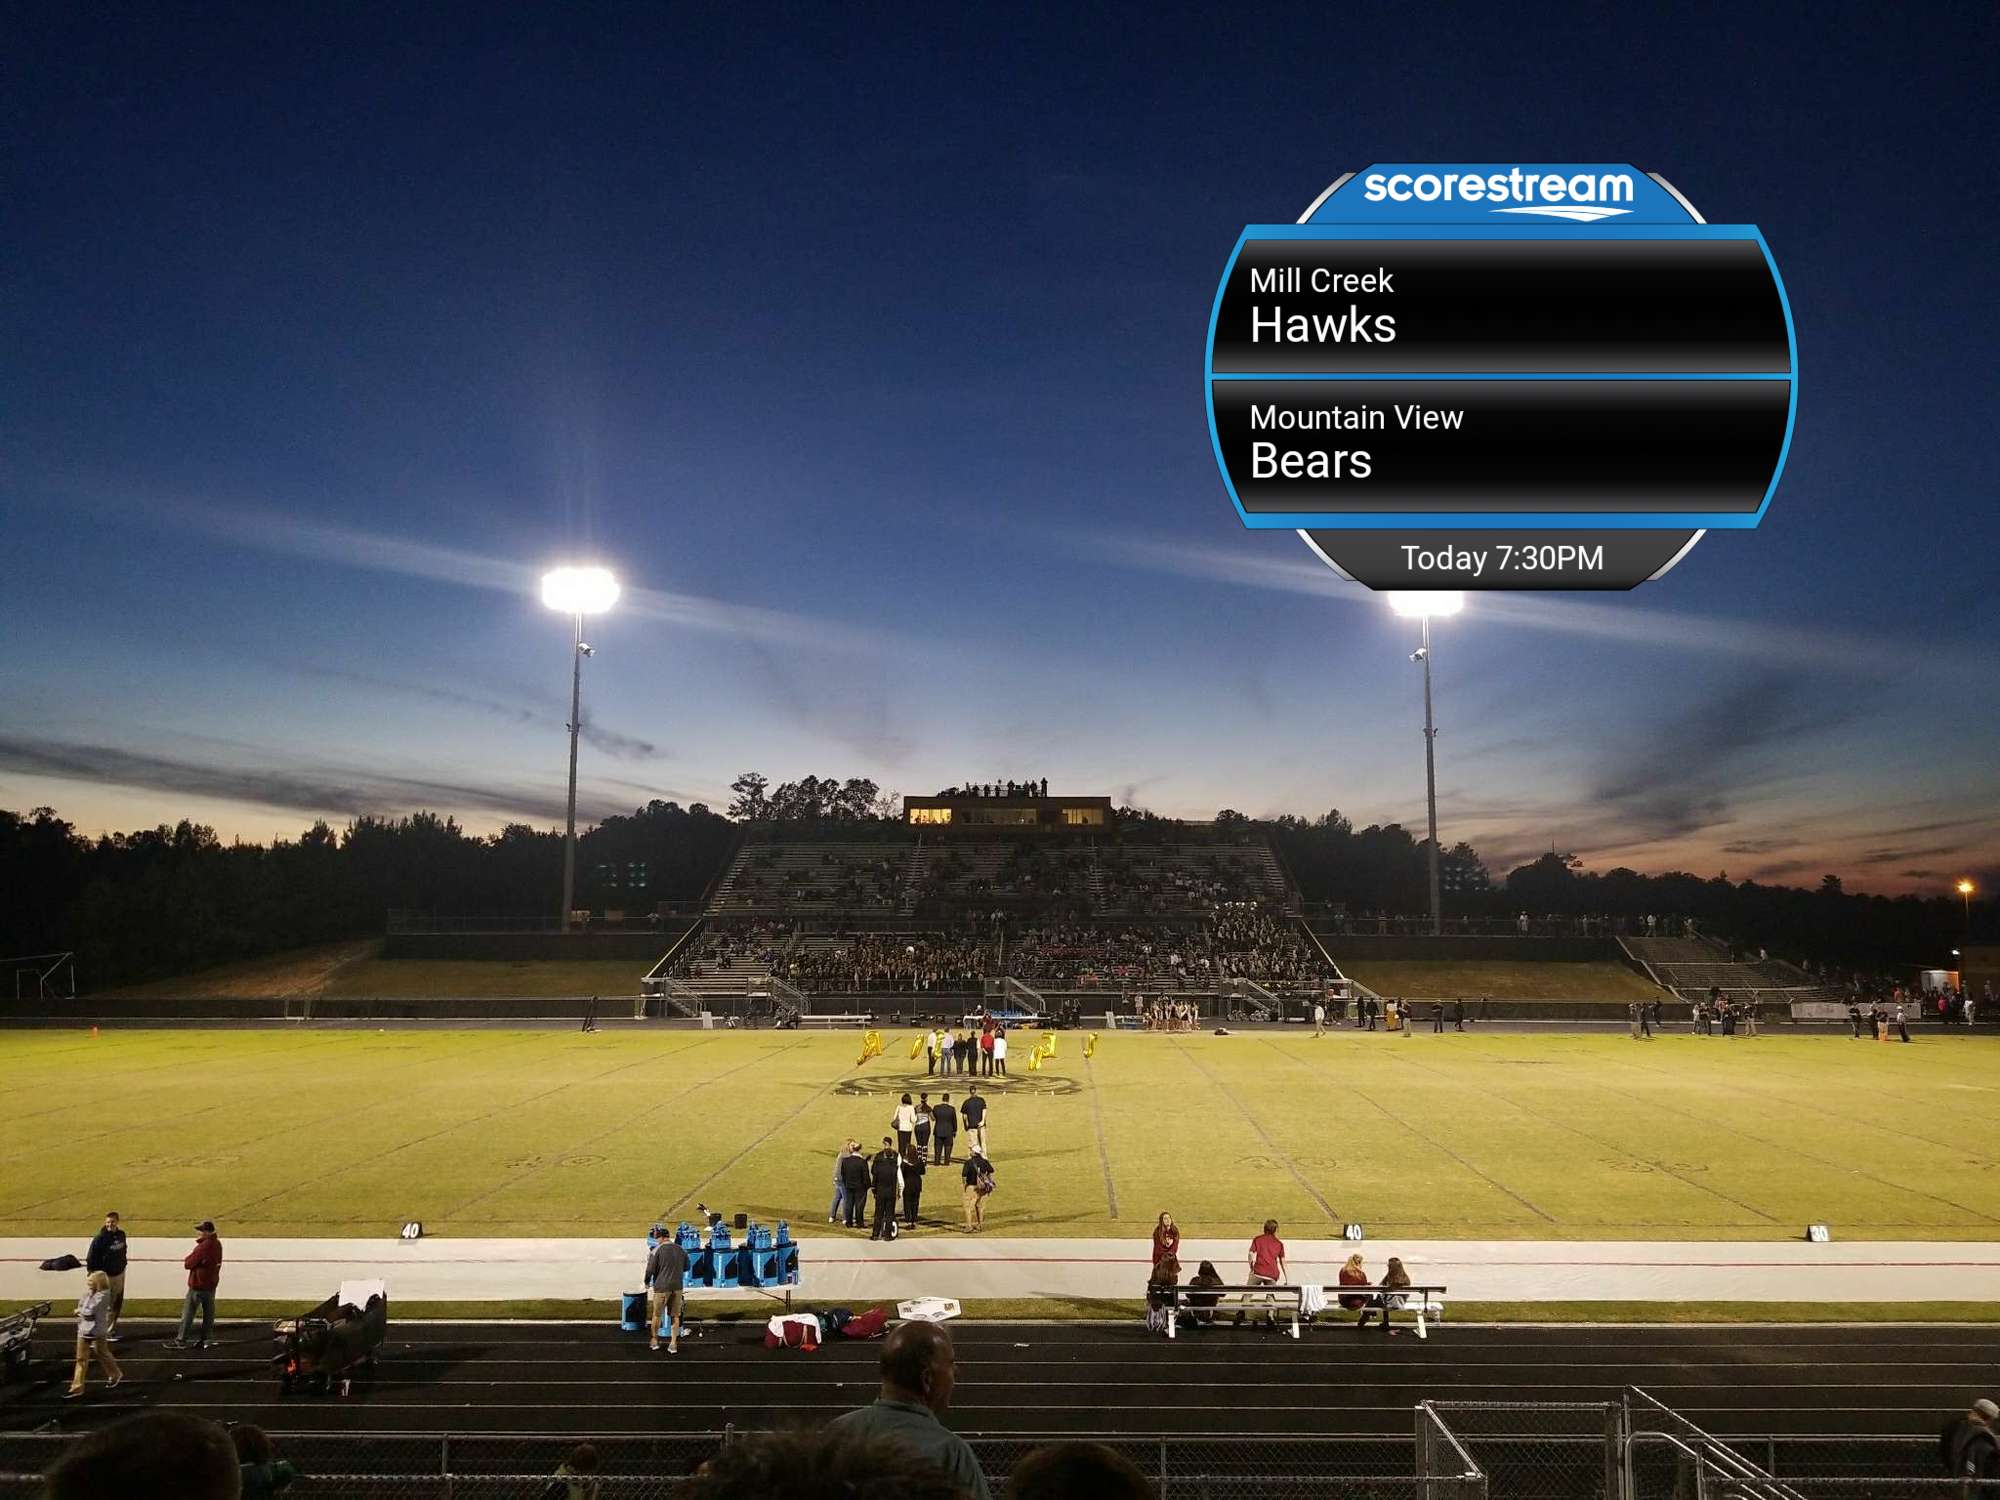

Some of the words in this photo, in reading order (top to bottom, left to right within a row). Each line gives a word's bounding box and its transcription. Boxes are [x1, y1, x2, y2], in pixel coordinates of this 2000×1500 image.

[402, 1223, 419, 1239] 40
[1346, 1224, 1362, 1240] 40
[1811, 1226, 1829, 1241] 30
